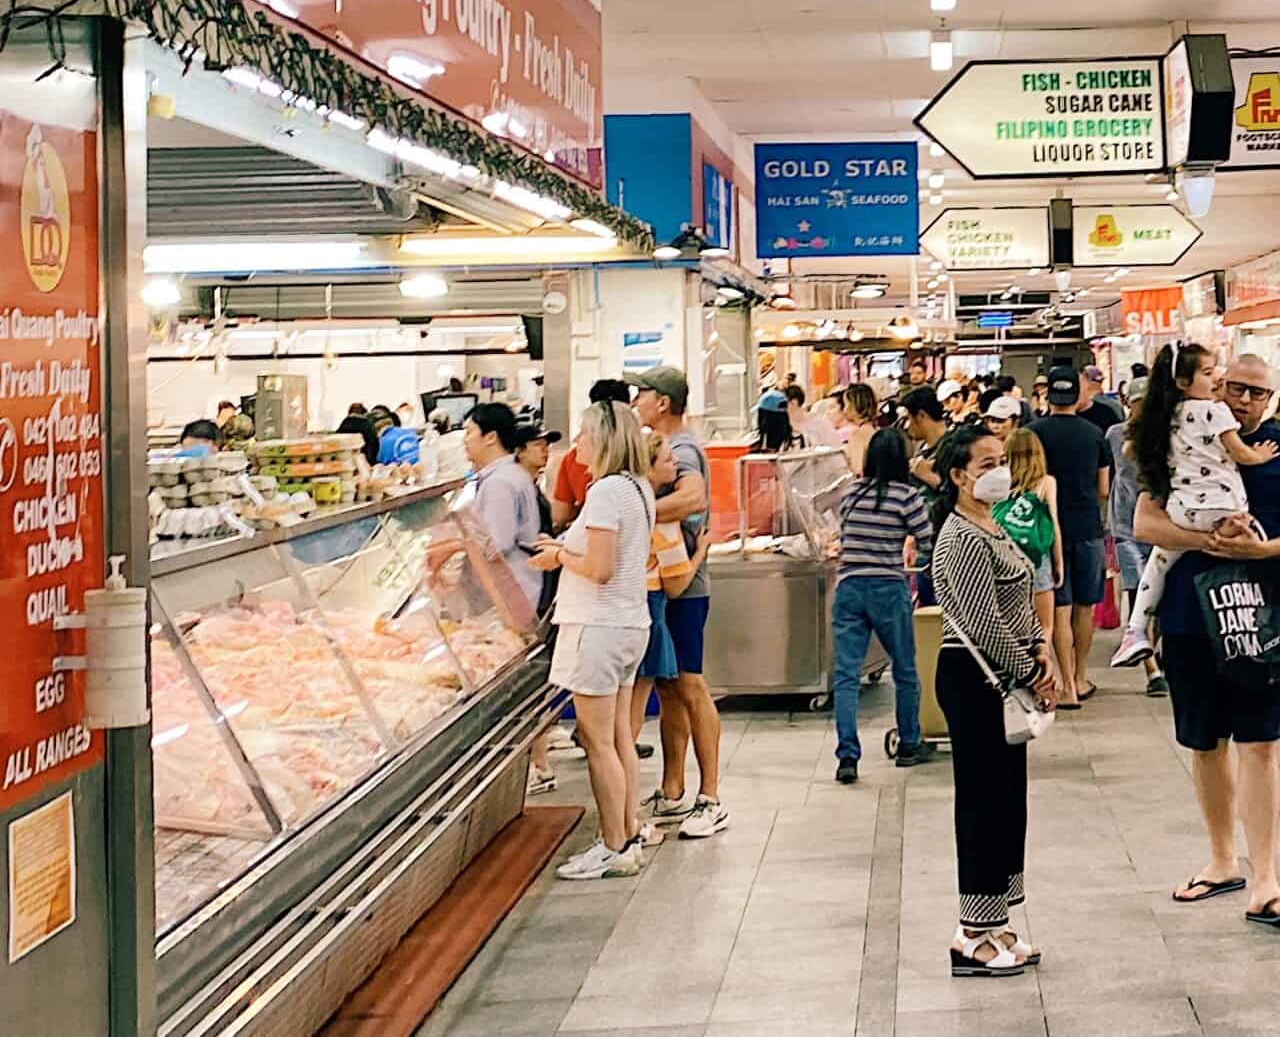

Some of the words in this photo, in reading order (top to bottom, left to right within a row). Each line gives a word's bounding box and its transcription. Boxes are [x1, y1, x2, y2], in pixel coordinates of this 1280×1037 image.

[524, 11, 562, 104] Fresh
[1022, 72, 1061, 92] FISH
[1075, 70, 1152, 90] CHICKEN
[1046, 94, 1104, 113] SUGAR
[1109, 93, 1153, 113] CANE
[996, 120, 1068, 140] FILIPINO
[1073, 118, 1153, 138] GROCERY
[1032, 144, 1095, 164] LIQUOR
[1100, 141, 1155, 161] STORE
[764, 160, 830, 179] GOLD
[845, 159, 909, 178] STAR
[767, 197, 792, 207] HAI
[794, 195, 820, 207] SAN
[851, 194, 909, 205] SEAFOOD
[1133, 229, 1172, 241] MEAT
[14, 492, 77, 534] CHICKEN
[27, 584, 69, 626] QUAIL
[1209, 582, 1265, 610] LORNA
[1218, 607, 1259, 635] JANE
[36, 673, 65, 713] EGG
[2, 746, 32, 790] ALL
[34, 724, 91, 776] RANGES
